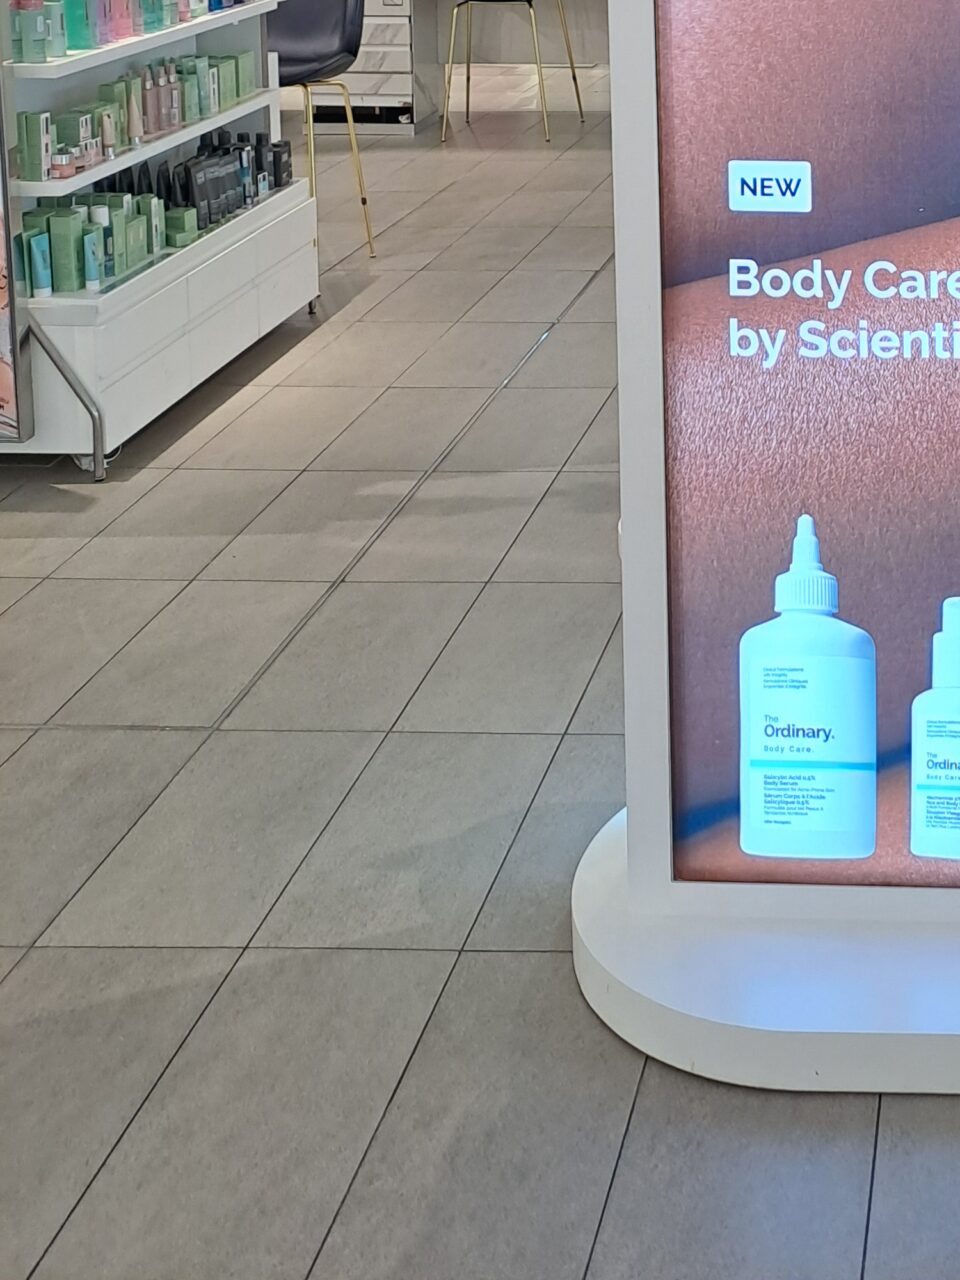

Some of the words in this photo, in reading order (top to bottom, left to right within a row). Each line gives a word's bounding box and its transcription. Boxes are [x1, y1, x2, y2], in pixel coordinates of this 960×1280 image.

[740, 177, 802, 197] NEW
[728, 258, 852, 310] Body
[729, 317, 787, 368] by
[764, 714, 779, 723] The
[764, 724, 835, 743] Ordinary.
[763, 745, 785, 754] Body
